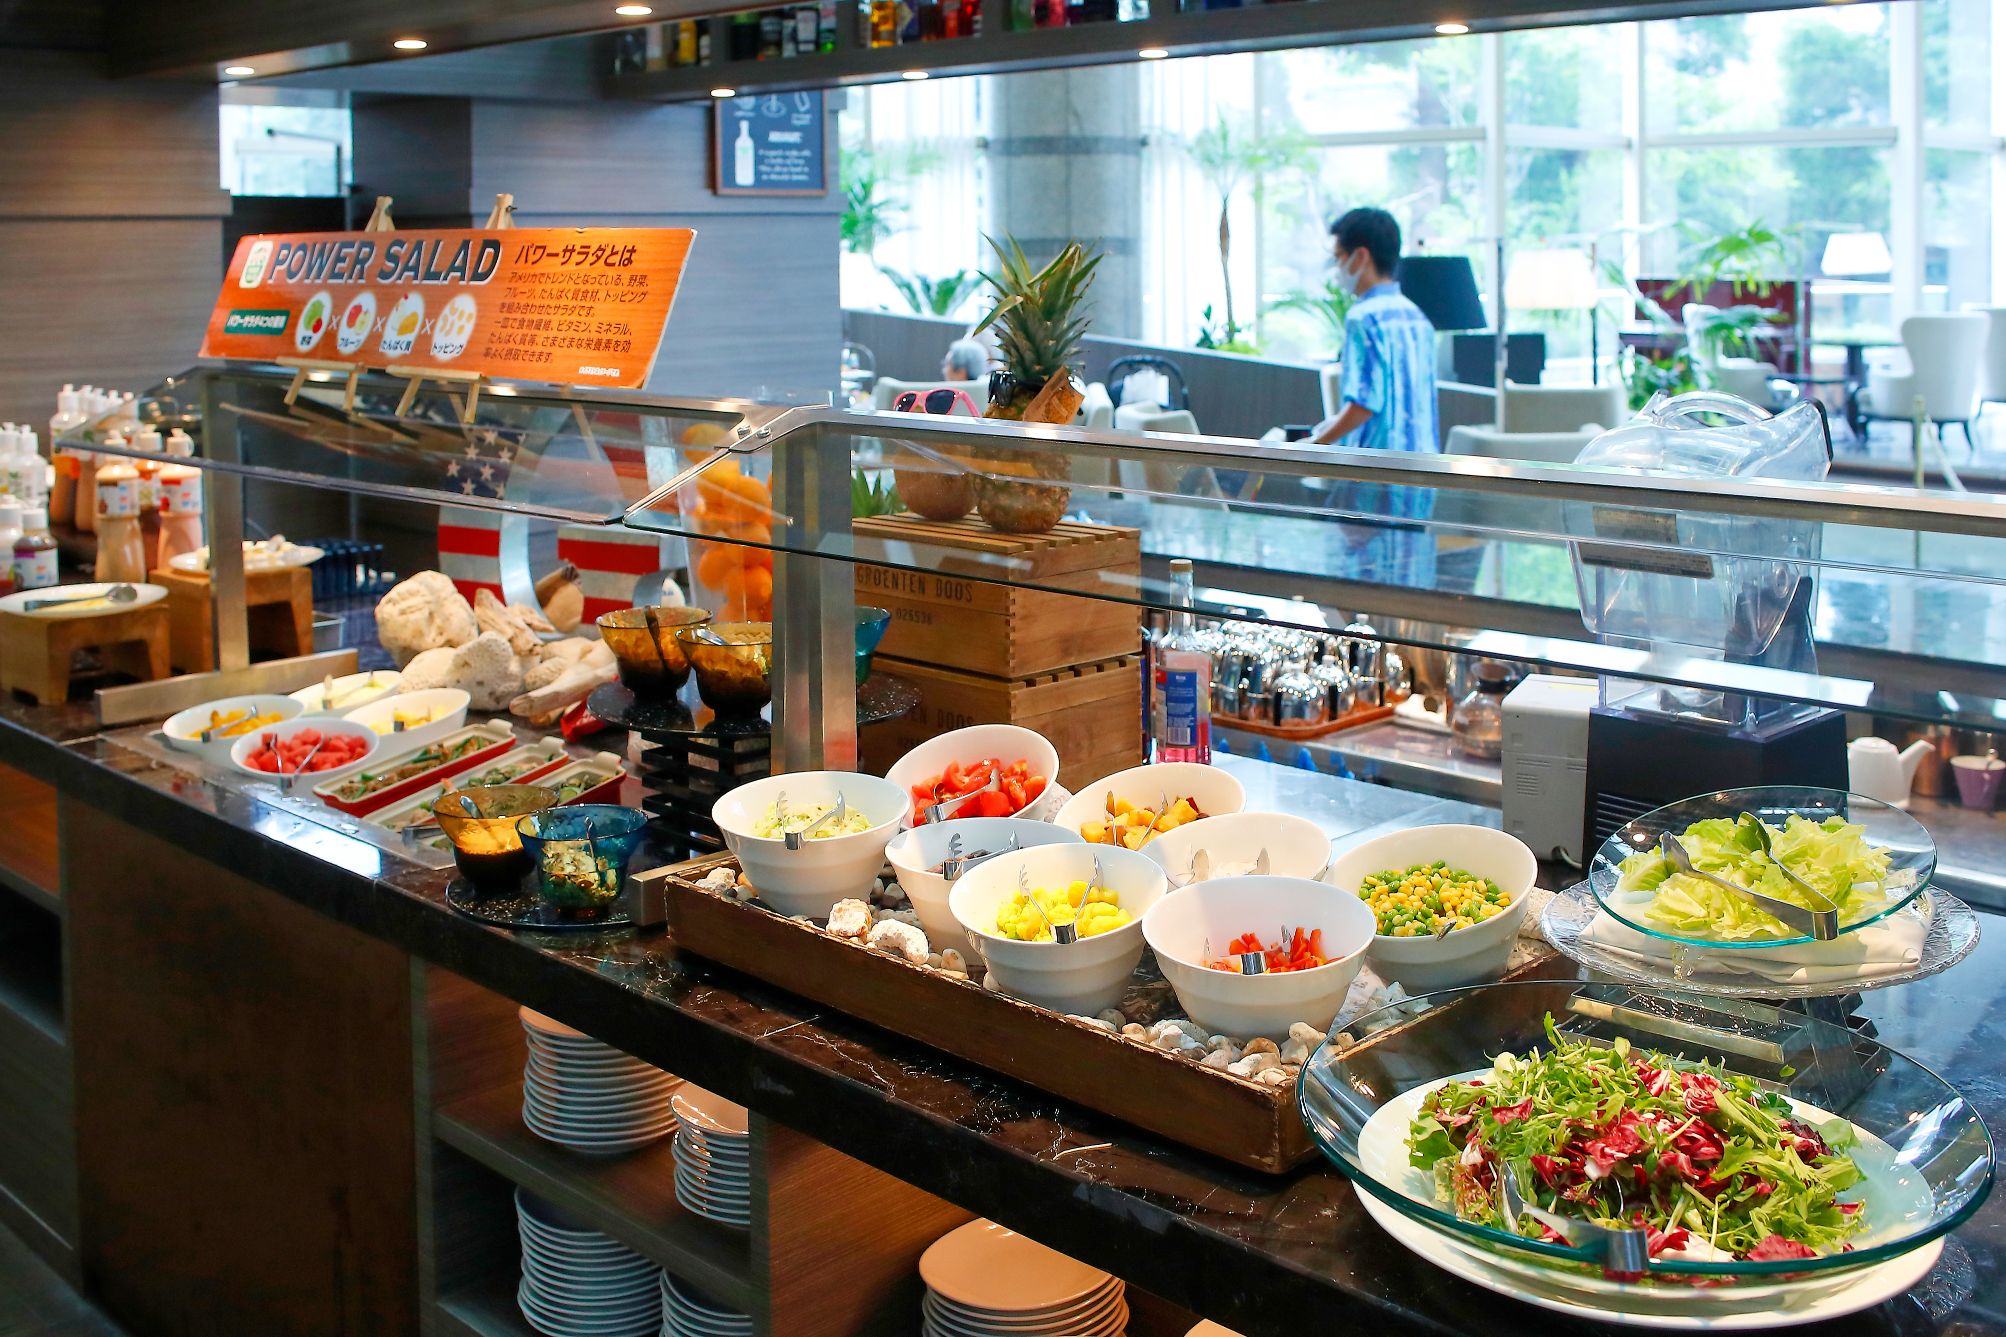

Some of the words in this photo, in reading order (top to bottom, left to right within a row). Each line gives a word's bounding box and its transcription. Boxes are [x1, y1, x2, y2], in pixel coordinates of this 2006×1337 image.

[267, 240, 376, 285] POWER
[376, 239, 503, 286] SALAD
[515, 244, 638, 267] パワーサラダとは
[432, 343, 465, 355] トッピング
[855, 564, 926, 596] GROENTEN
[936, 578, 973, 602] DOOS
